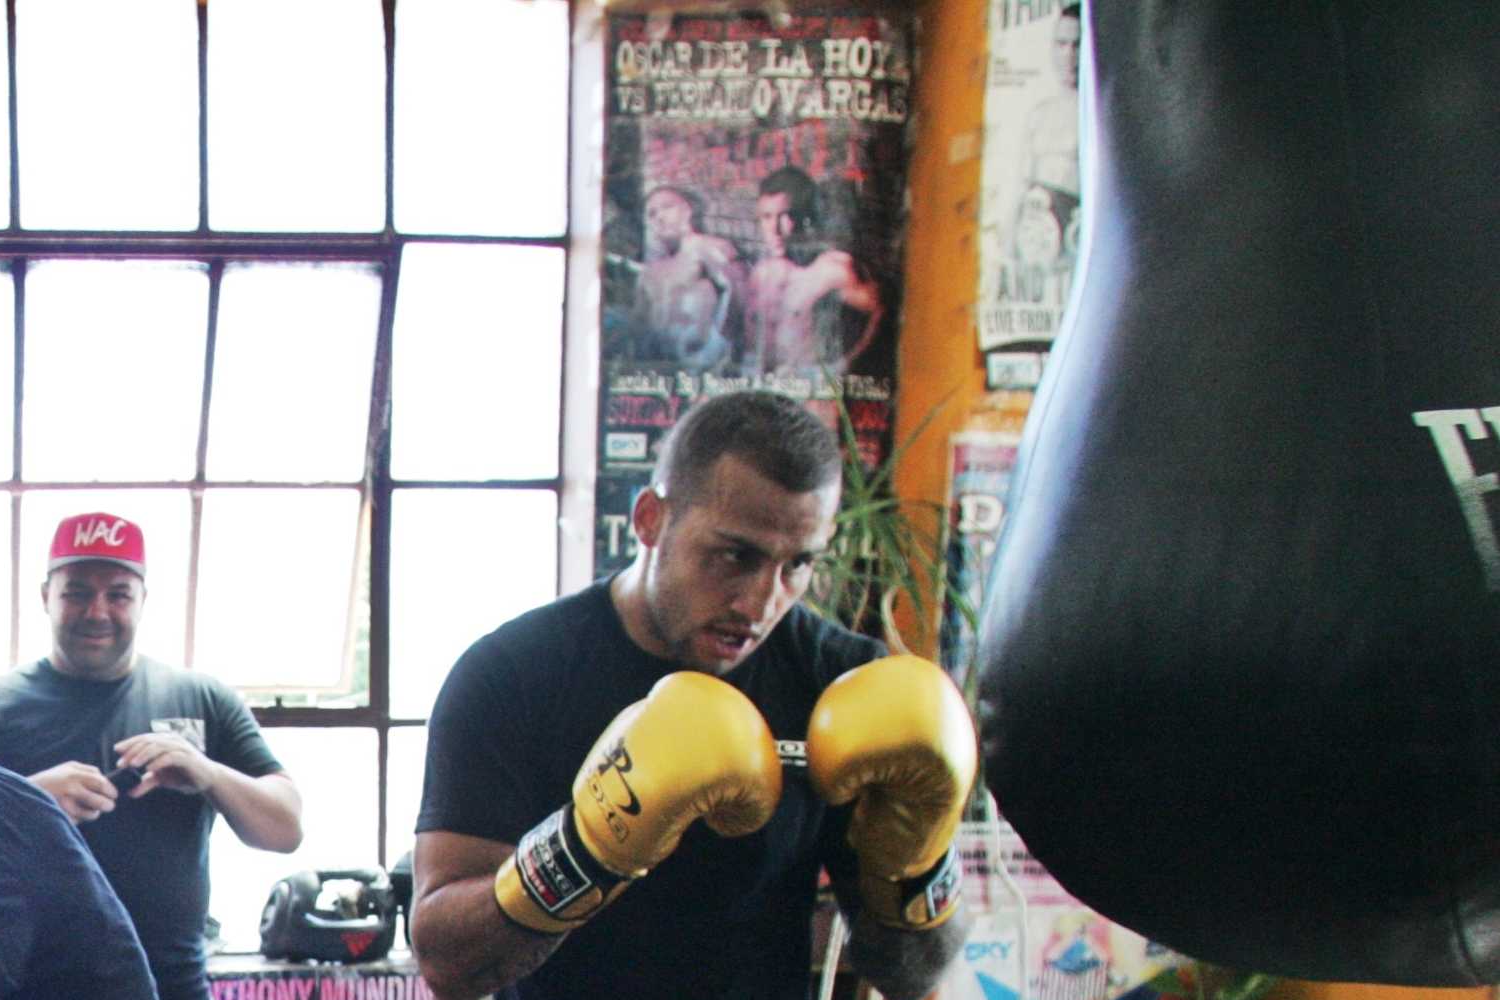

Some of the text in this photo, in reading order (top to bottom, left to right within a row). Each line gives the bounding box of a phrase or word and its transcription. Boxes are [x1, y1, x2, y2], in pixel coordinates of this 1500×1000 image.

[617, 40, 693, 82] OSCAR
[701, 40, 749, 78] DE
[759, 38, 814, 78] LA
